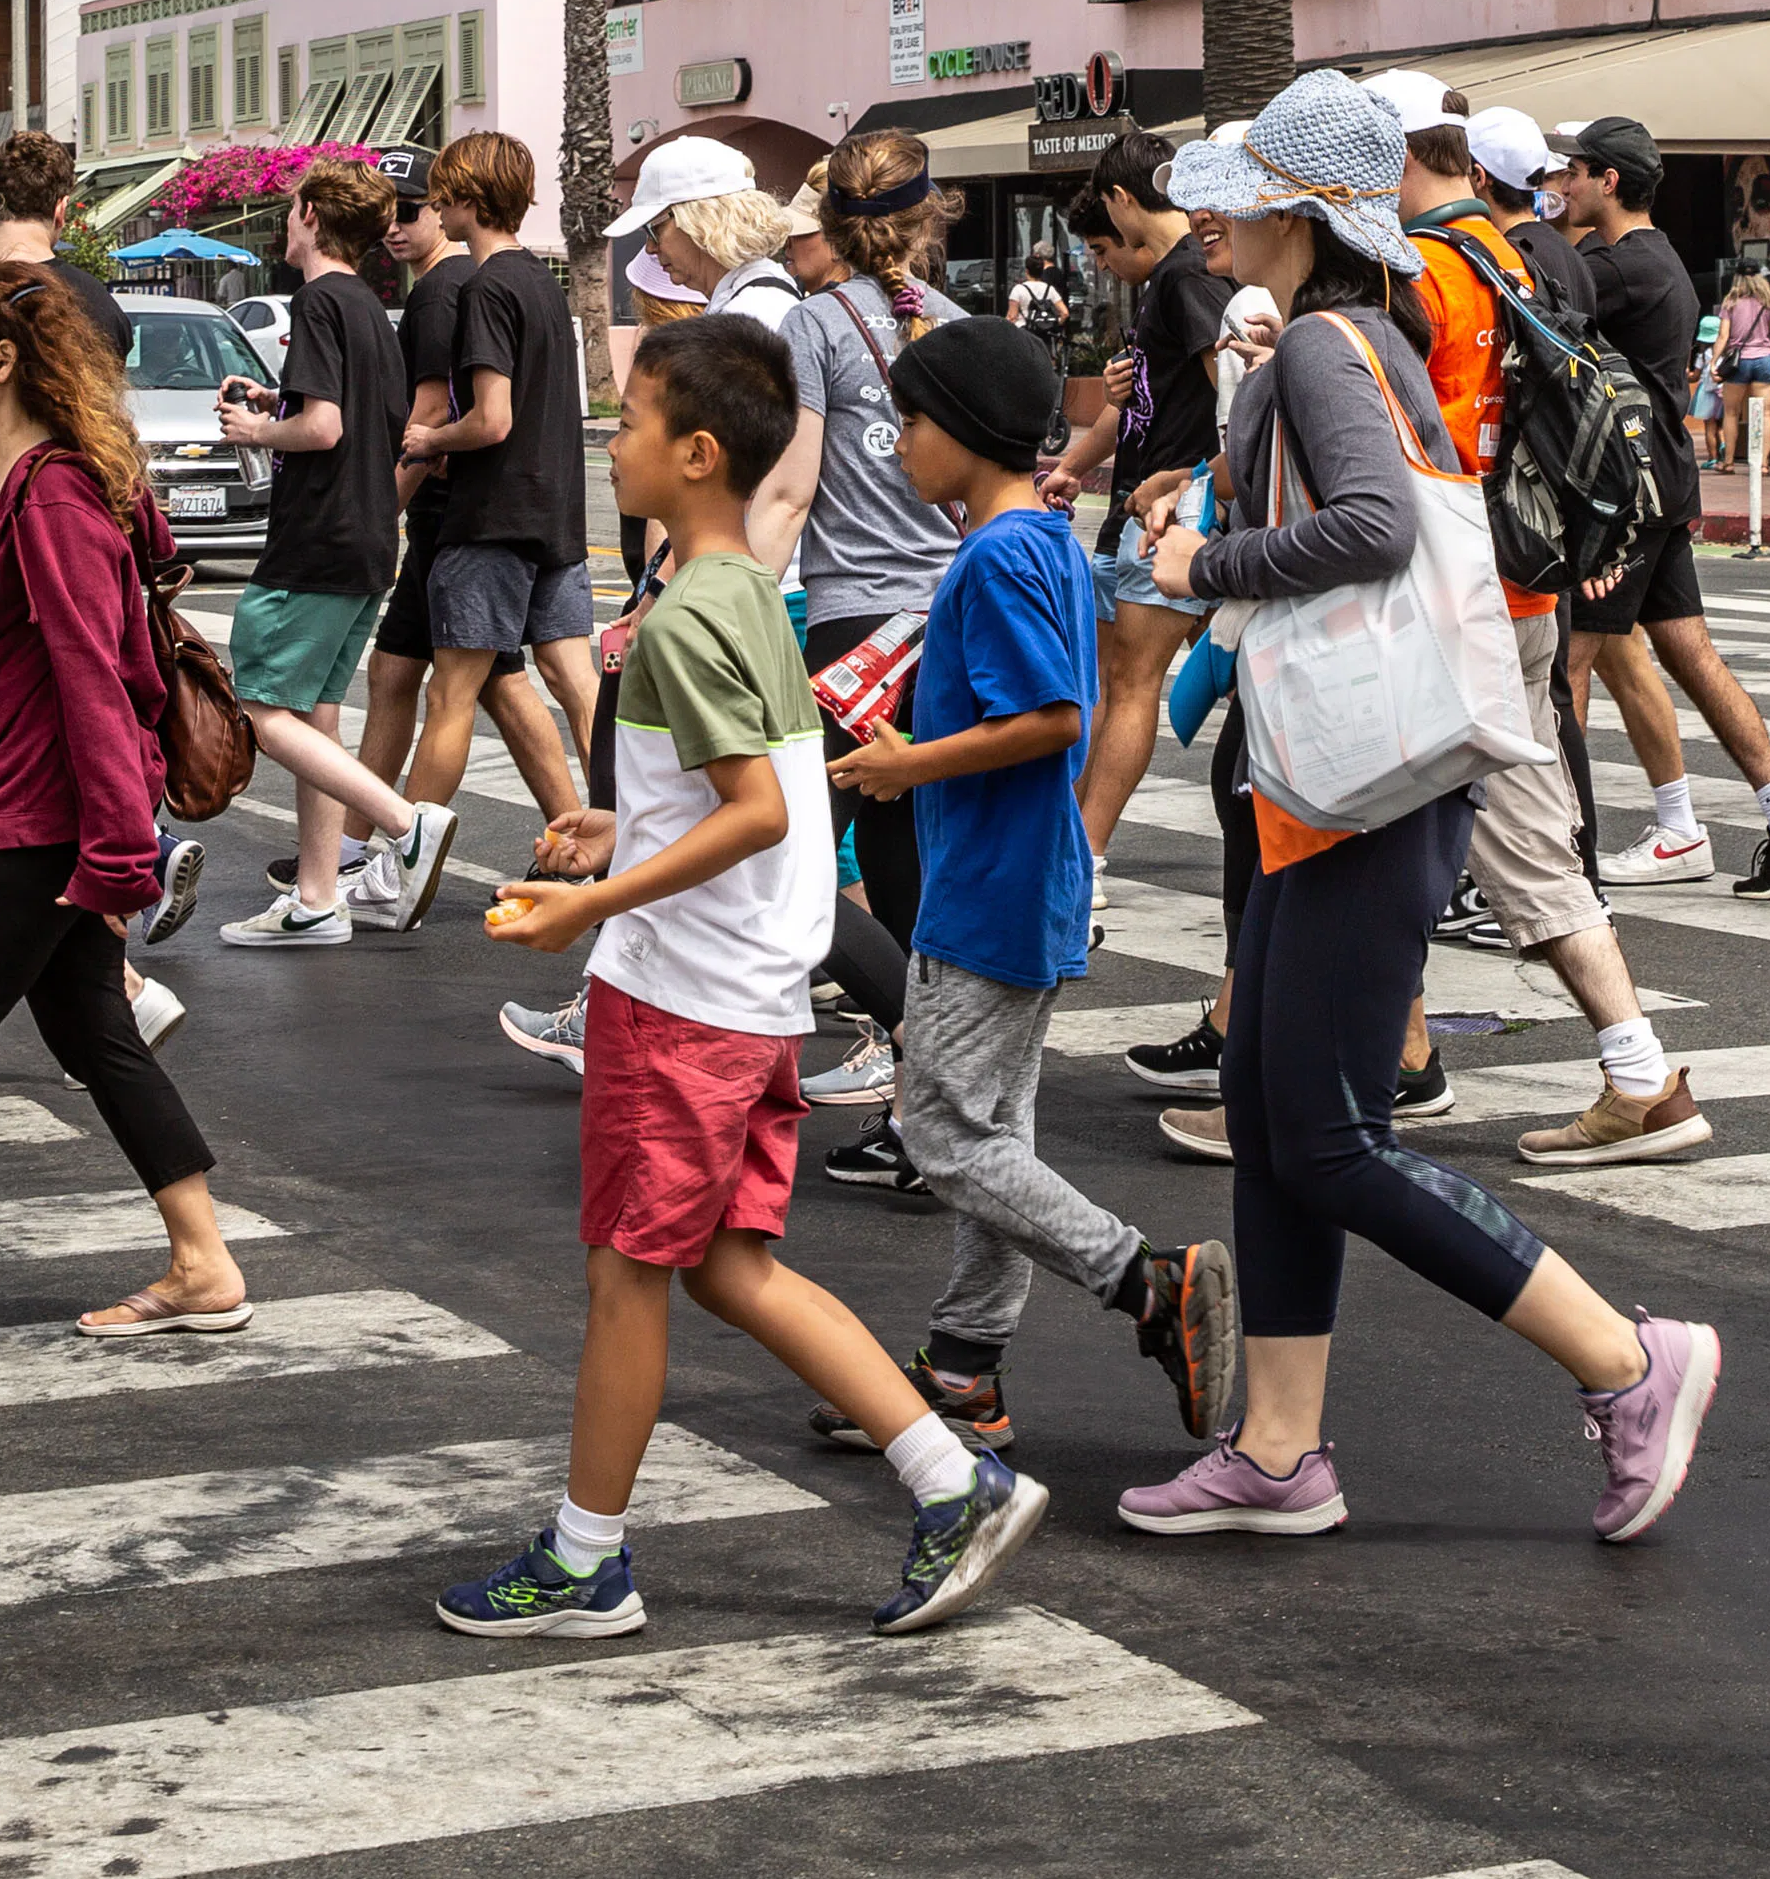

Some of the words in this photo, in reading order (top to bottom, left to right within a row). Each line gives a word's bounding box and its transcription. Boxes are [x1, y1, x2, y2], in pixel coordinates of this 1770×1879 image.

[927, 42, 1028, 80] CYCLEHOUSE
[684, 72, 732, 97] PARKING
[1033, 73, 1082, 122] RED
[1086, 50, 1115, 116] O
[1032, 137, 1062, 155] TASTE
[1063, 135, 1076, 153] OF
